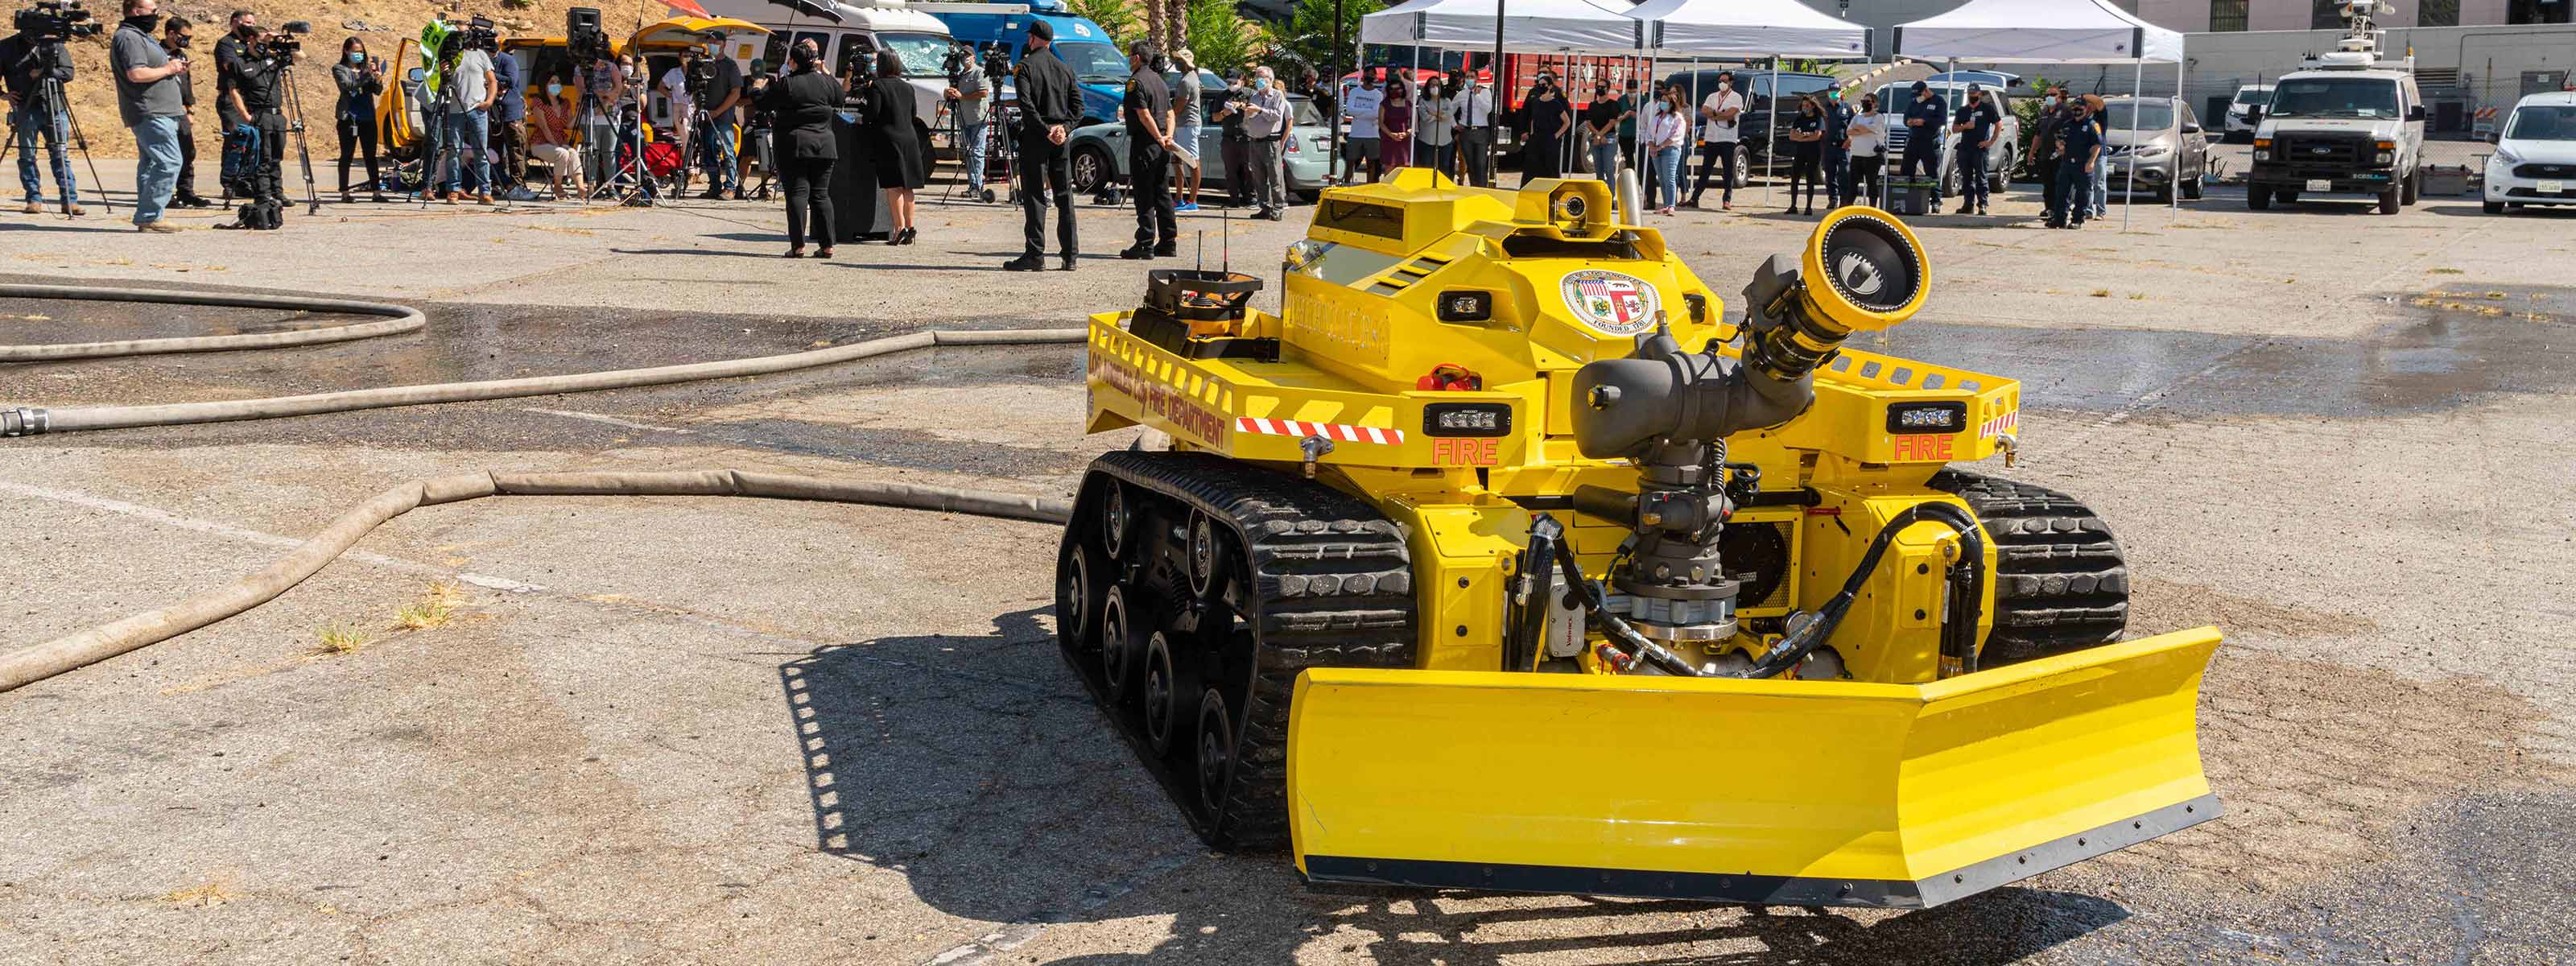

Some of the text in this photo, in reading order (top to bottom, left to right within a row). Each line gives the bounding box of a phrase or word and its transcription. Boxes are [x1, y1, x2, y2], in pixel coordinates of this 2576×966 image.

[1594, 320, 1646, 331] FOUNDED 1781
[1150, 385, 1166, 417] FIRE
[1168, 392, 1226, 450] DEPARTMENT
[1433, 438, 1498, 465] FIRE
[1894, 435, 1953, 461] FIRE
